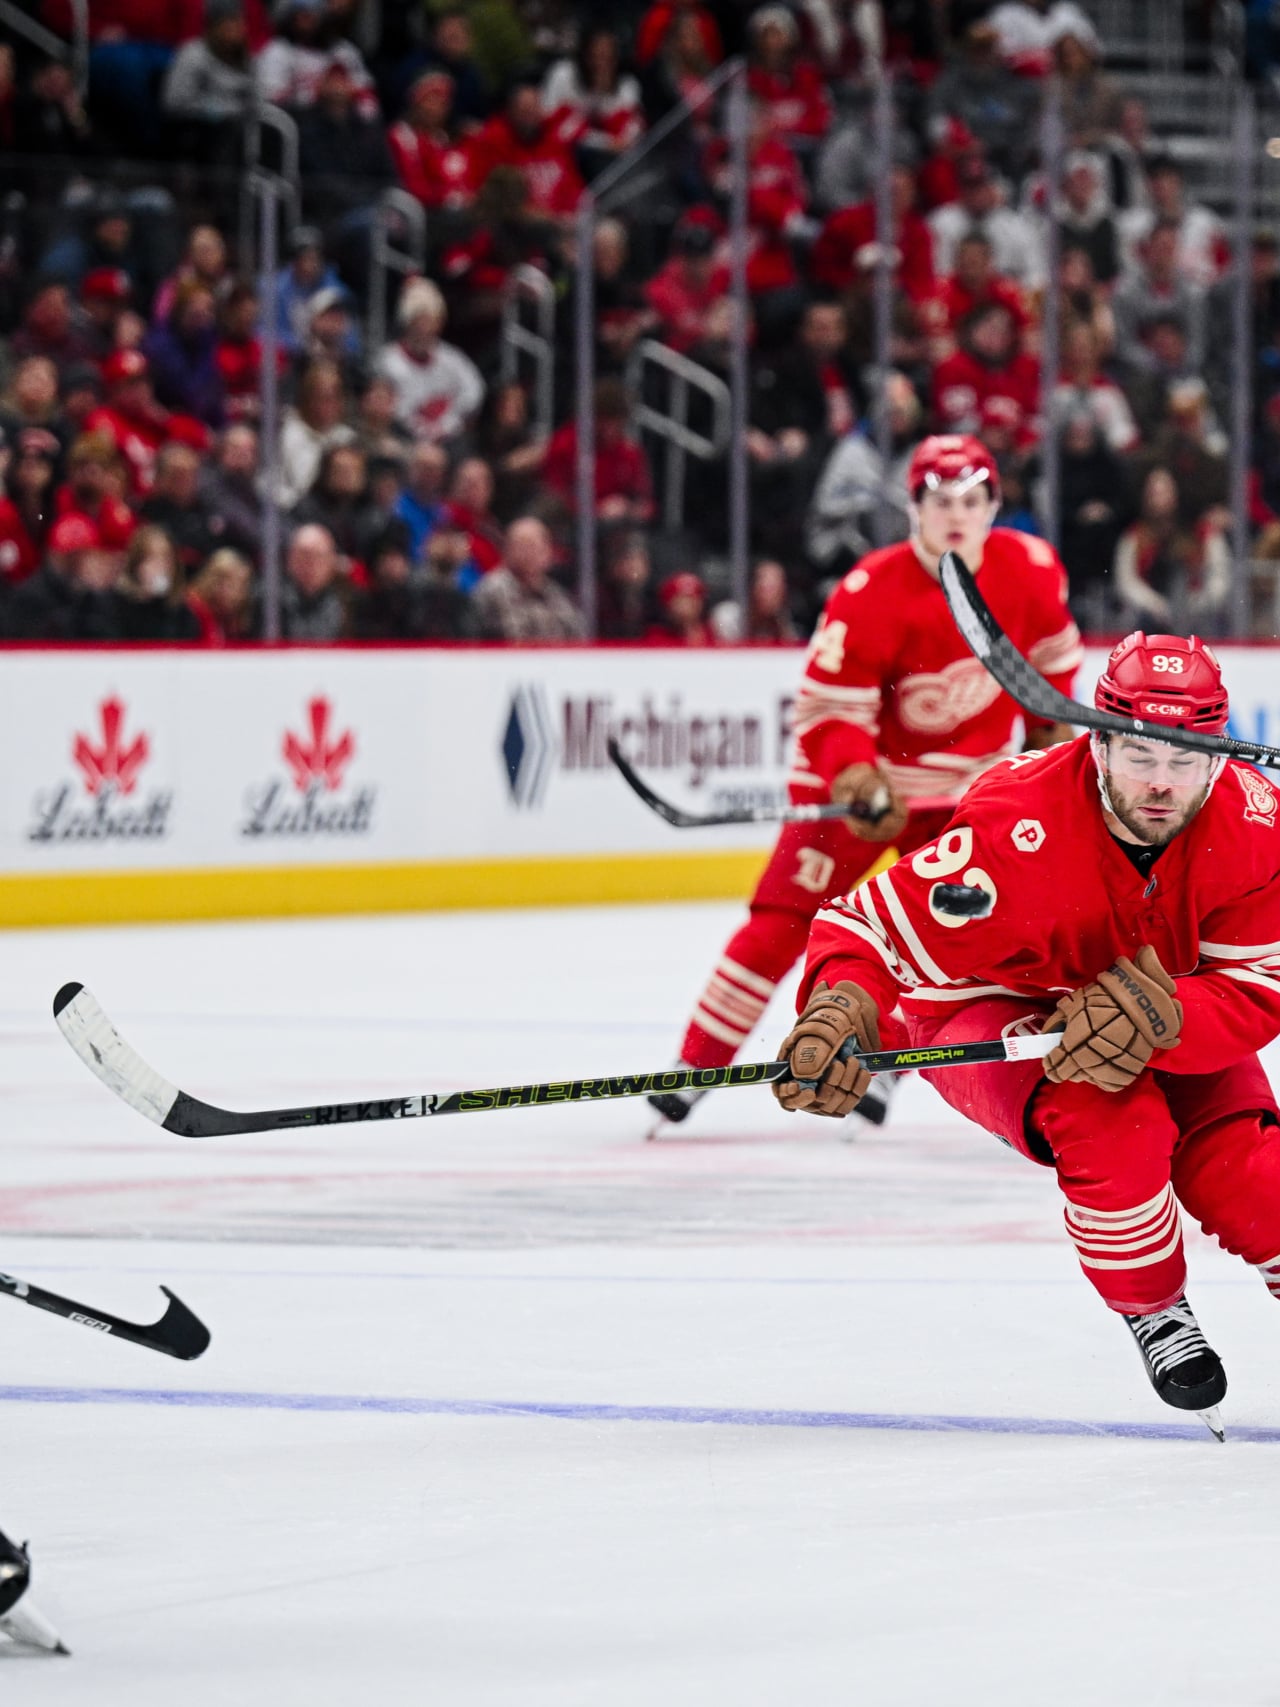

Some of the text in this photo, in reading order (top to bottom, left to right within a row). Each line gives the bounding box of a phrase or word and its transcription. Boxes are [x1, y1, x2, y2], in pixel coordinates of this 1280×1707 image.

[1152, 655, 1184, 674] 93
[894, 1048, 953, 1065] MORPH
[459, 1063, 768, 1112] SHERWOOD
[316, 1093, 440, 1125] REKKER
[70, 1312, 108, 1331] CCM
